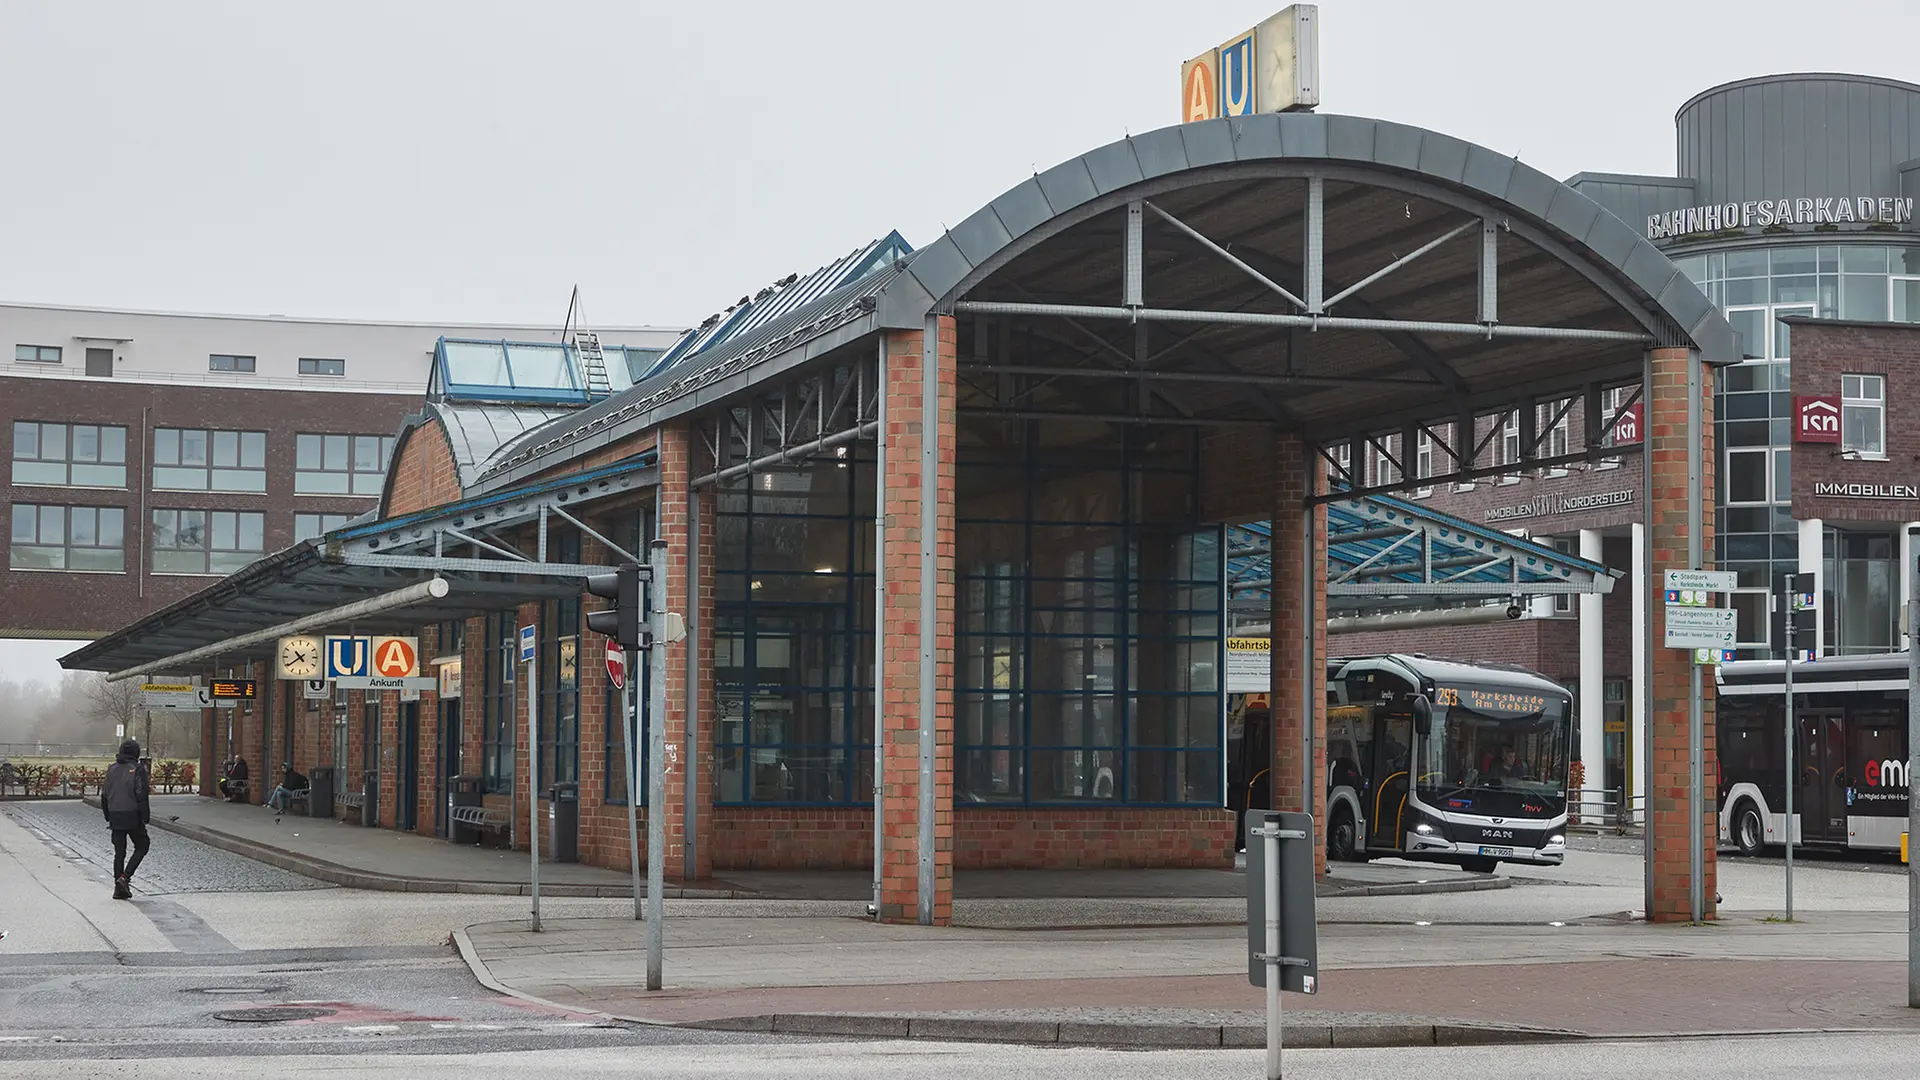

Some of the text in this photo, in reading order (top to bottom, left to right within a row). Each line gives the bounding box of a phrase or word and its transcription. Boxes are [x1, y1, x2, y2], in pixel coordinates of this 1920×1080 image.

[1225, 44, 1248, 116] U
[1189, 65, 1209, 123] A
[1647, 196, 1913, 240] BAHNHOFSARKADEN
[1815, 482, 1918, 497] IMMOBILIEN
[1671, 592, 1676, 600] 3
[333, 641, 363, 676] U
[381, 641, 409, 673] A
[144, 684, 188, 692] Abfahrtsbereich
[369, 678, 404, 688] Ankunft
[1437, 687, 1544, 706] 293 Harksheide
[1475, 699, 1540, 712] Am Gehölz
[1525, 804, 1542, 813] hvv
[1482, 829, 1513, 839] MAN
